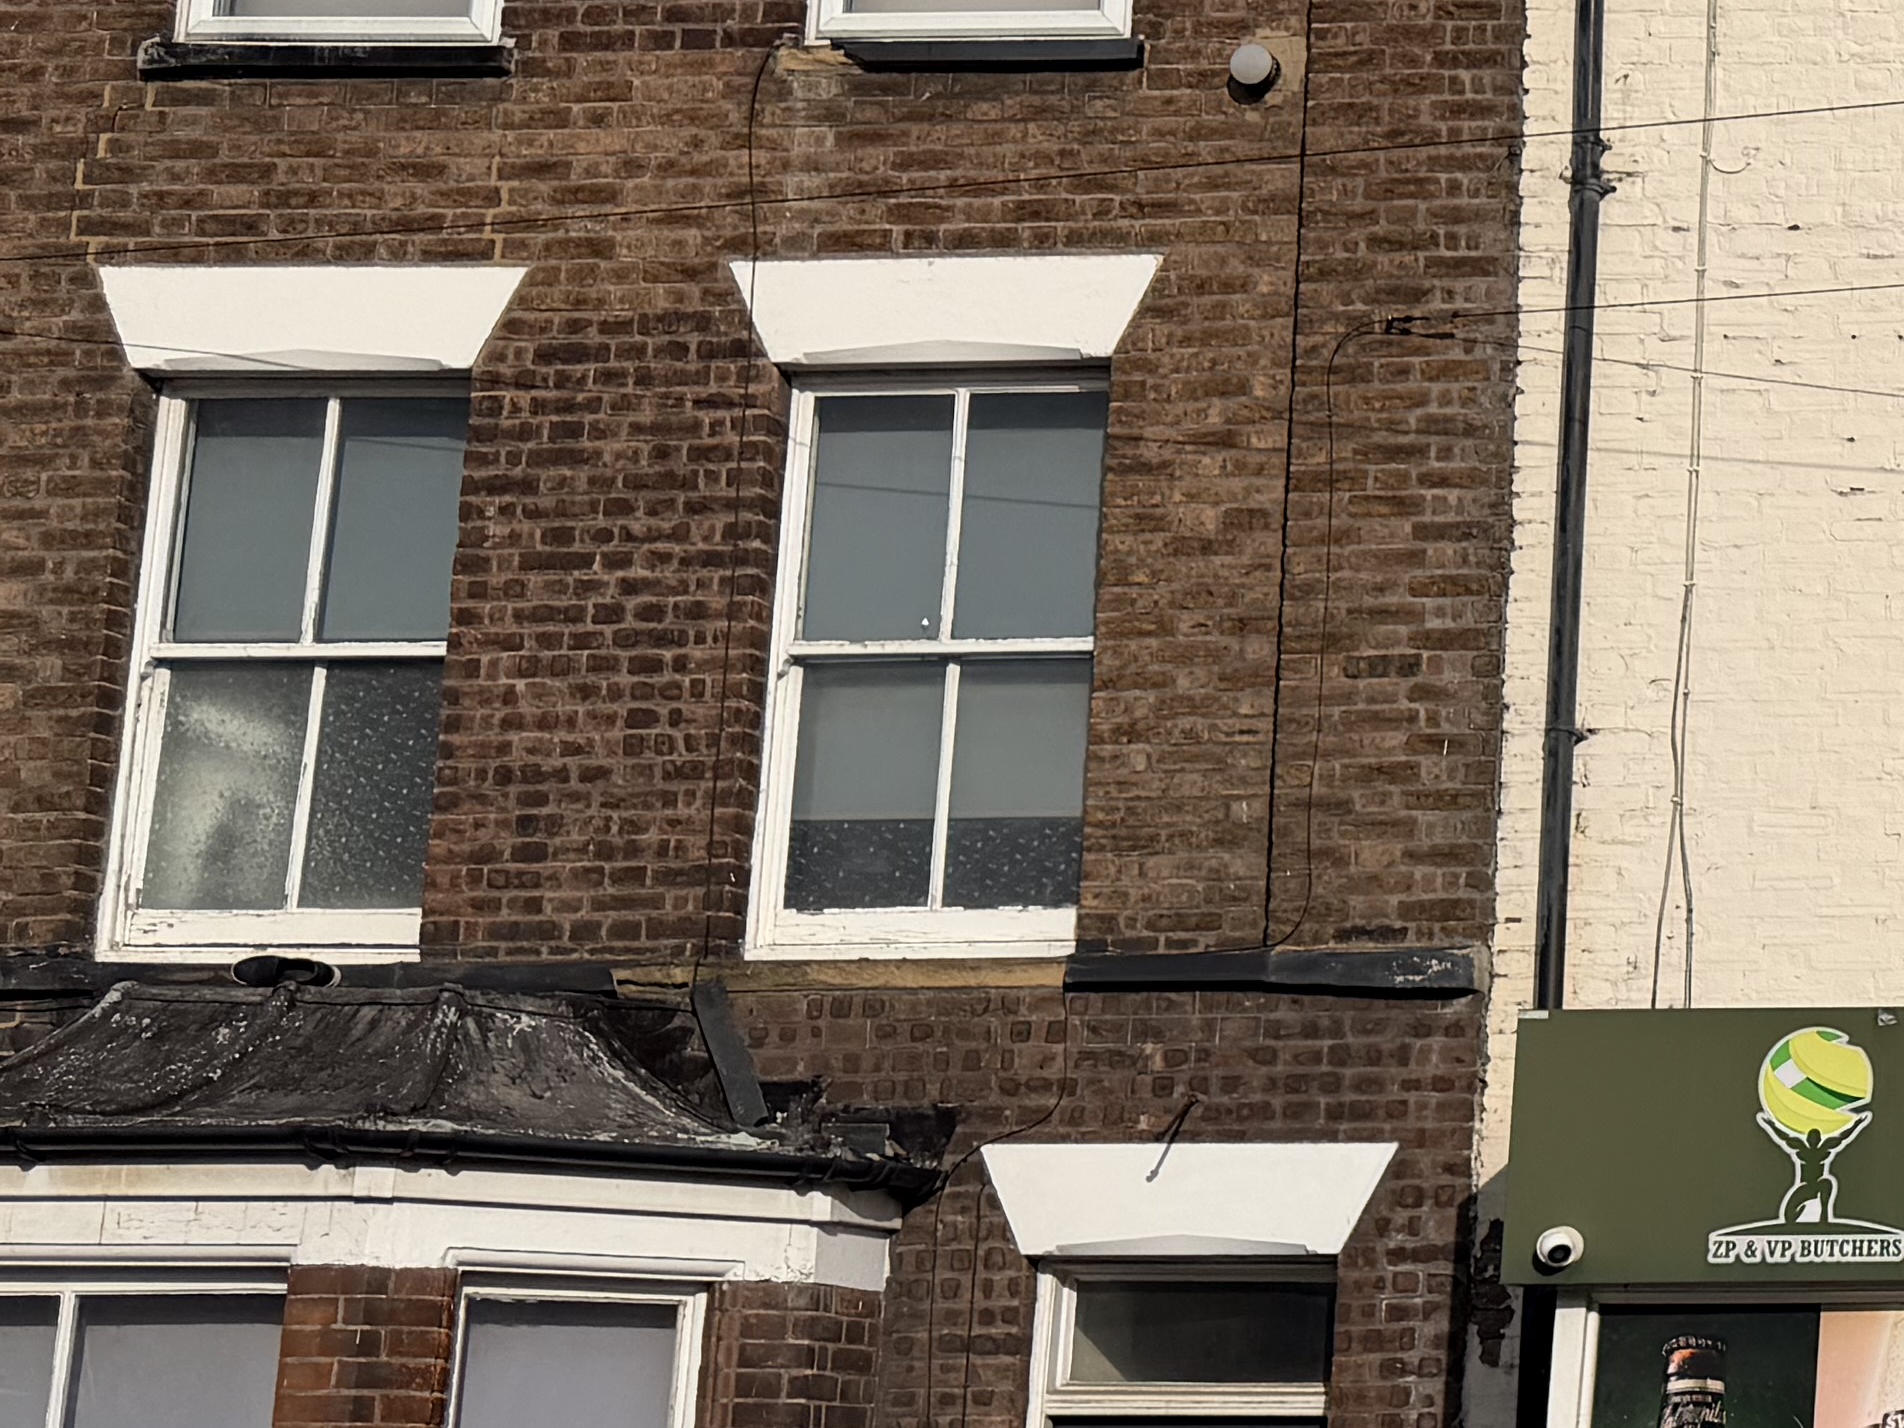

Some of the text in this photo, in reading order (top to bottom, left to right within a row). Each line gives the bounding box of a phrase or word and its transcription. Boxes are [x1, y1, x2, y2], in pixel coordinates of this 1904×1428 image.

[1712, 1239, 1901, 1258] ZP & VP BUTCHERS
